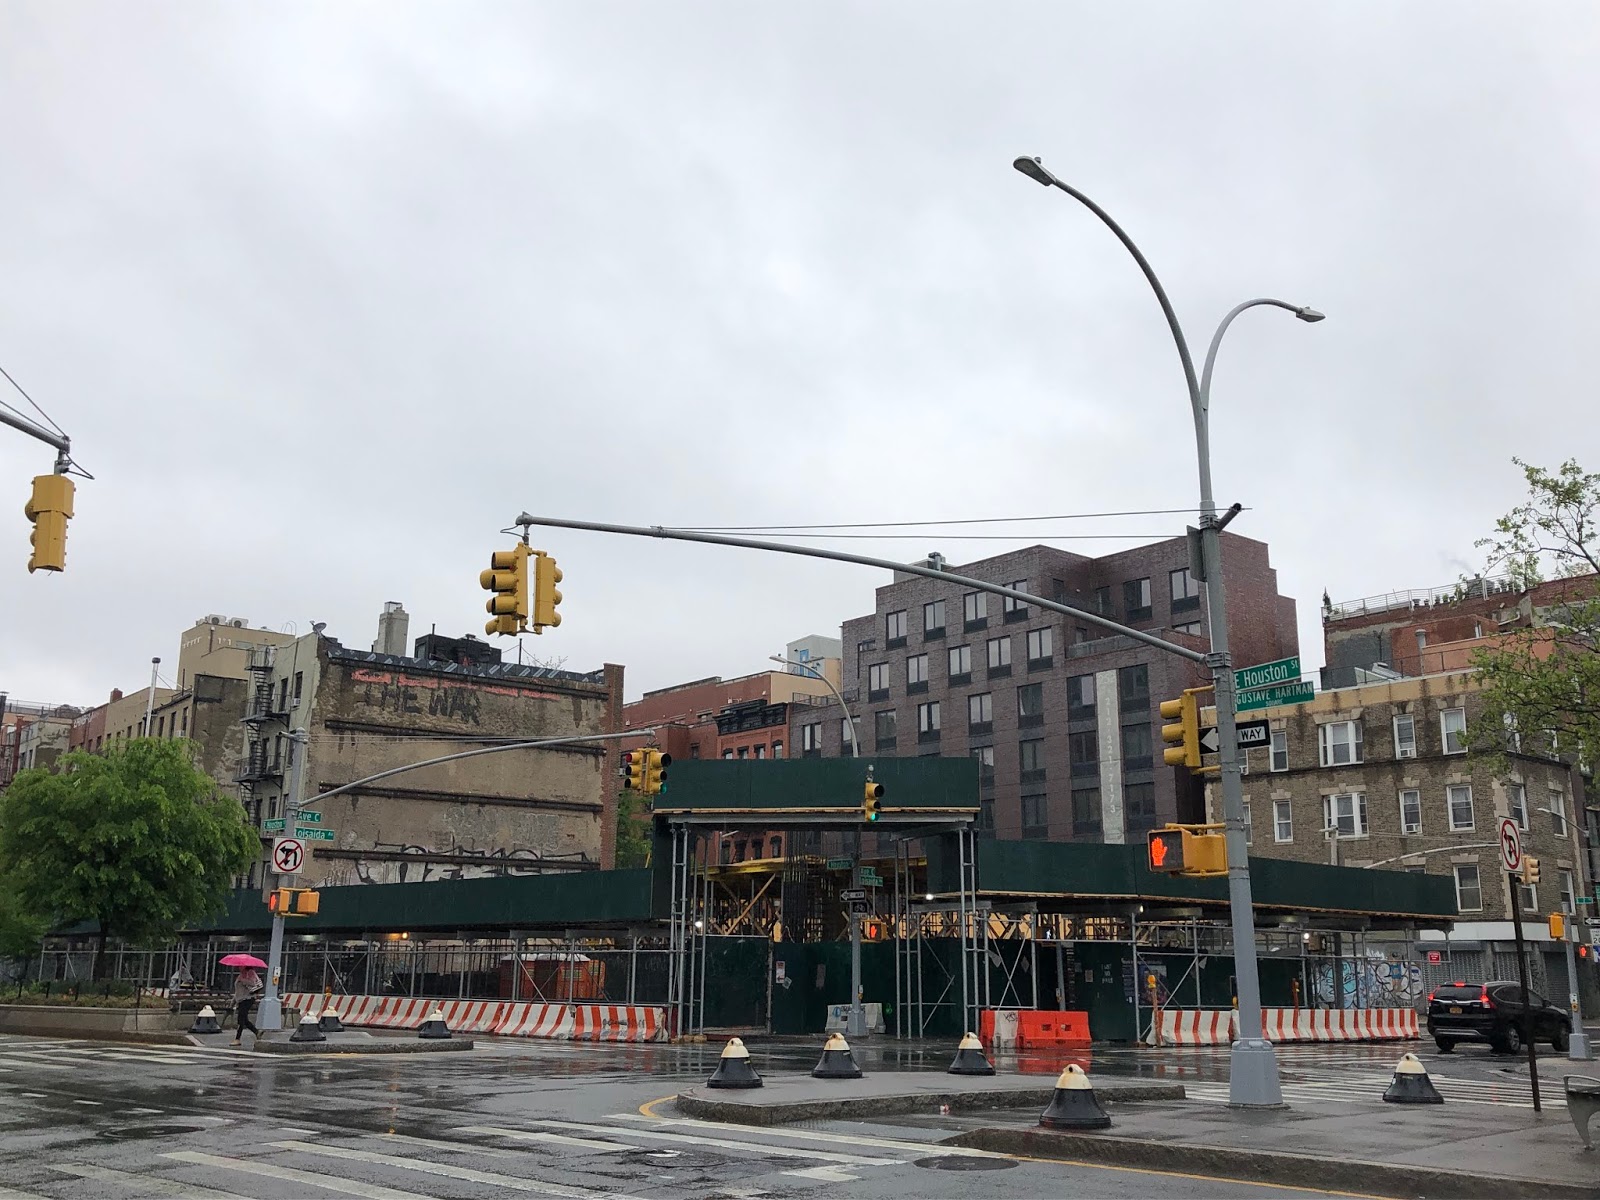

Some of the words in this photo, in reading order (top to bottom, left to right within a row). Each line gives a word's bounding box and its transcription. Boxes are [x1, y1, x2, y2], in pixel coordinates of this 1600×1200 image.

[1234, 673, 1240, 689] E
[1243, 665, 1288, 687] Houston
[1236, 689, 1271, 705] GUSTAVE
[1275, 682, 1313, 699] HARTMAN
[1241, 728, 1262, 741] WAY
[297, 811, 312, 821] Ave
[314, 813, 320, 822] C
